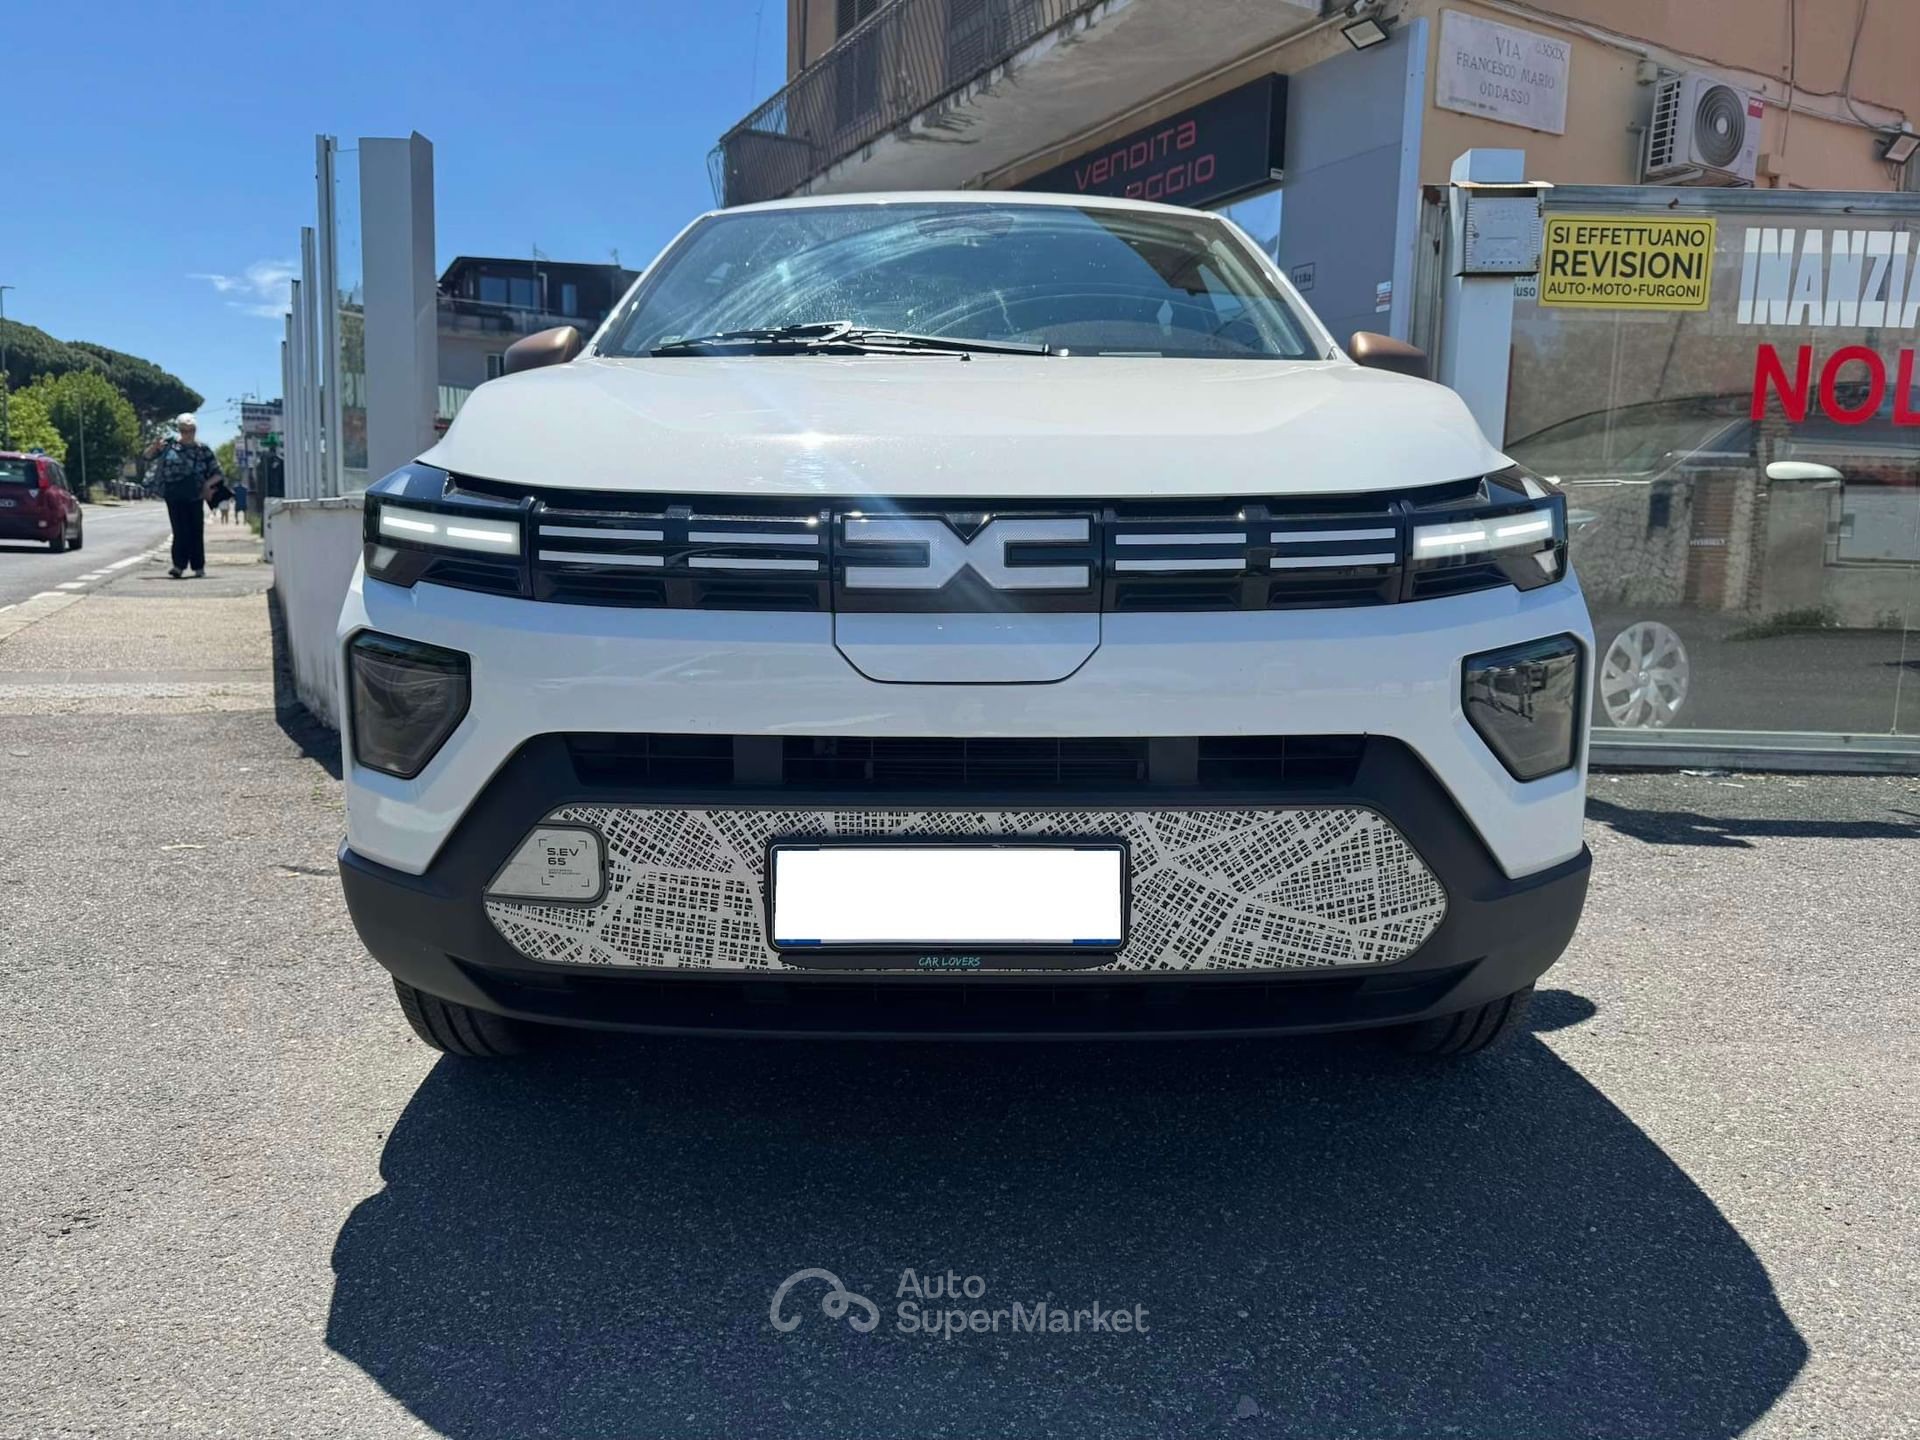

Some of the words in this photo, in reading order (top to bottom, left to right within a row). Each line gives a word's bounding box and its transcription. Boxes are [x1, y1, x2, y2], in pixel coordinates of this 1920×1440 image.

[1495, 37, 1521, 60] VIA
[1456, 51, 1515, 79] FRANCESCO
[1521, 68, 1555, 89] MARIO
[1479, 81, 1531, 105] ODDASSO
[1552, 226, 1570, 244] SI
[1576, 227, 1705, 247] EFFETTUANO
[1550, 250, 1704, 280] REVISIONI
[1751, 343, 1920, 427] NOL
[918, 956, 939, 967] CAR
[941, 956, 981, 968] LOVERS
